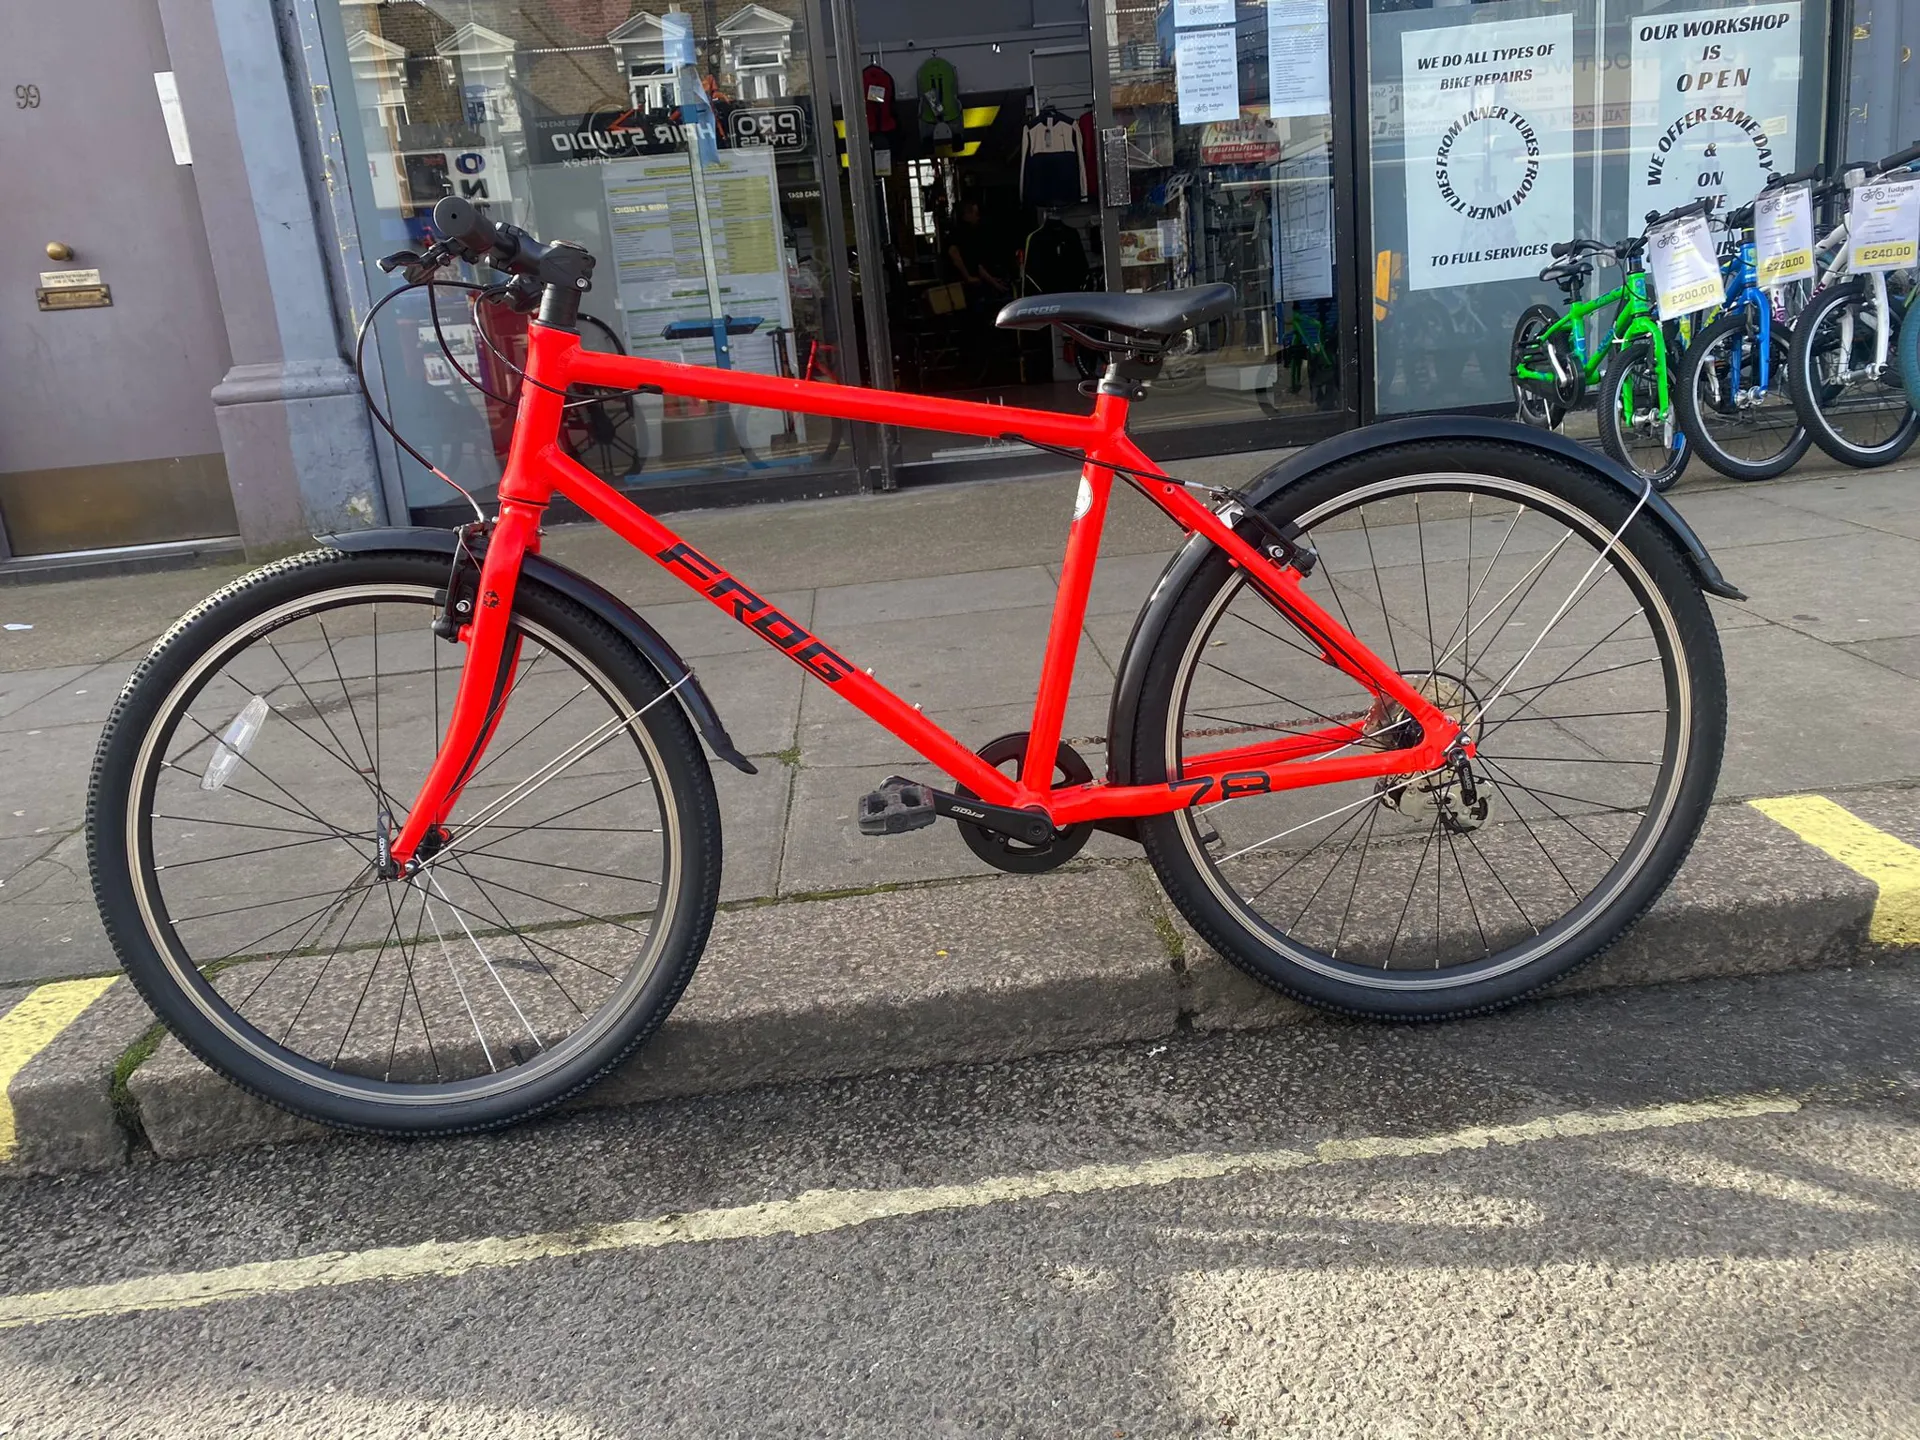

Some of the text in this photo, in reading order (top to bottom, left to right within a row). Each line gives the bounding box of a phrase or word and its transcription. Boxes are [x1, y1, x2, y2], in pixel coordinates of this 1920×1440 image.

[1640, 13, 1790, 42] OUR WORKSHOP
[1417, 44, 1556, 71] WE DO ALL TYPES OF
[1702, 44, 1721, 61] IS
[1440, 68, 1533, 91] BIKE REPAIRS
[1676, 67, 1752, 93] OPEN
[15, 84, 41, 110] 99
[1647, 105, 1774, 187] WE OFFER SAME DAY
[1703, 142, 1718, 158] &
[1435, 105, 1541, 220] FROM INNER TUBES FROM INNER TUBES
[1697, 170, 1724, 188] ON
[1431, 242, 1549, 268] TO FULL SERVICES
[1766, 255, 1805, 273] £220.00
[1863, 246, 1912, 261] £240.00
[1671, 284, 1715, 305] £200.00
[1016, 304, 1061, 317] FROG
[655, 542, 857, 683] FROG
[1168, 770, 1272, 807] 78
[950, 804, 986, 819] FROG
